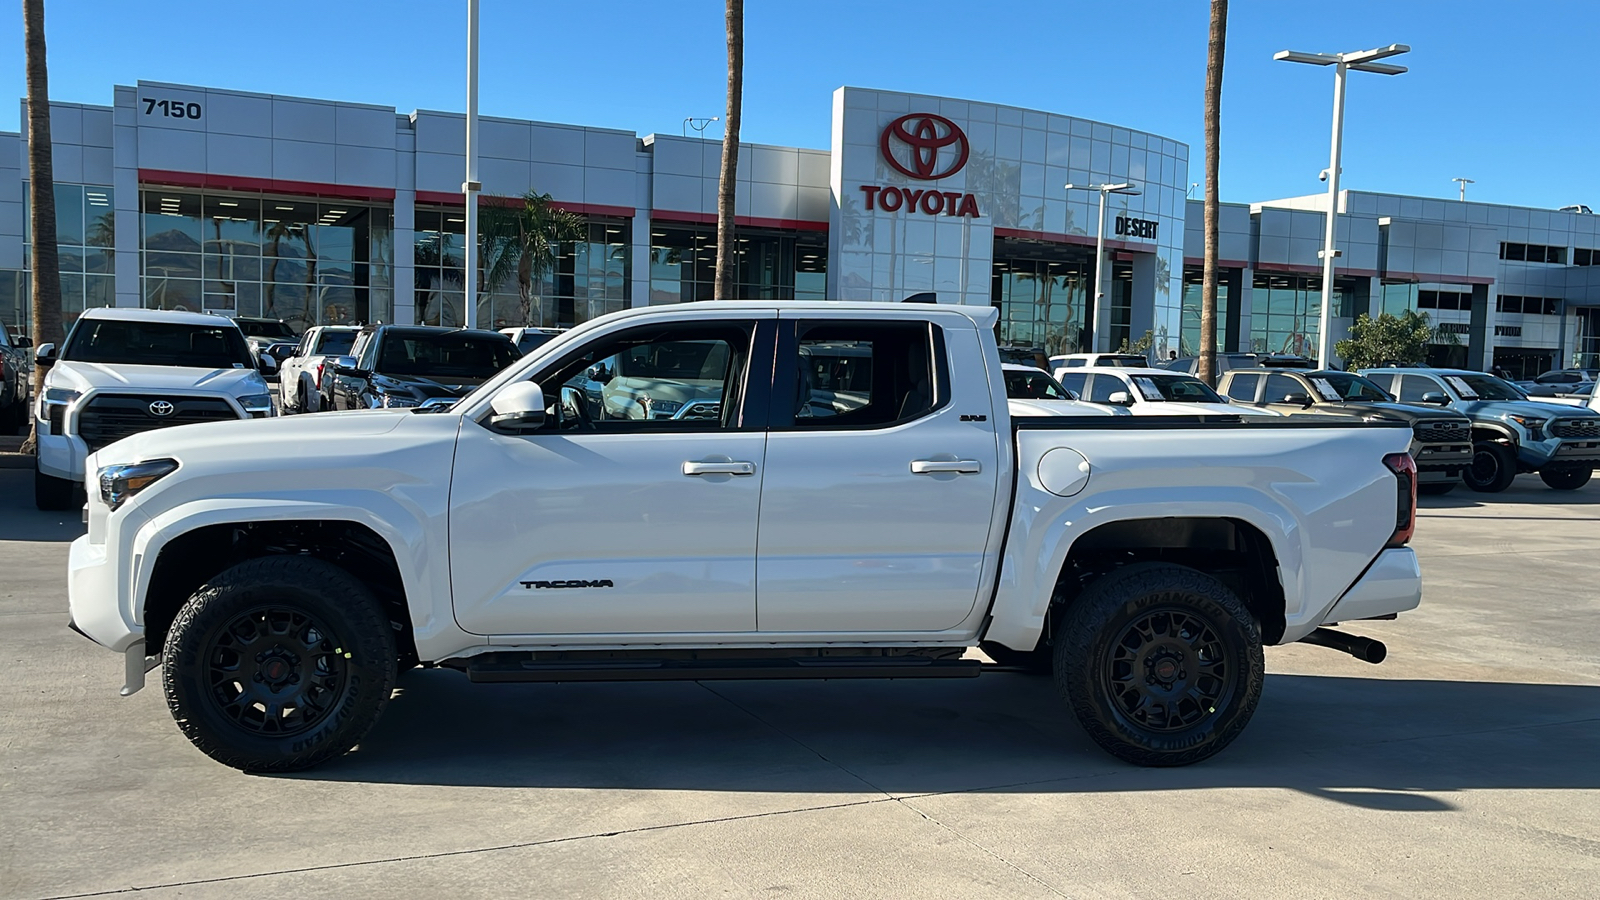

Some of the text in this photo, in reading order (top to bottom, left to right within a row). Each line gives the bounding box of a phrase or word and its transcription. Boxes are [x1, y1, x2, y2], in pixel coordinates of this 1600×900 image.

[142, 97, 202, 120] 7150
[859, 185, 980, 218] TOYOTA
[1115, 216, 1158, 239] DESERT
[519, 579, 614, 589] TACOMA
[1133, 591, 1224, 619] WRANGLER
[291, 674, 362, 754] GOODYEAR
